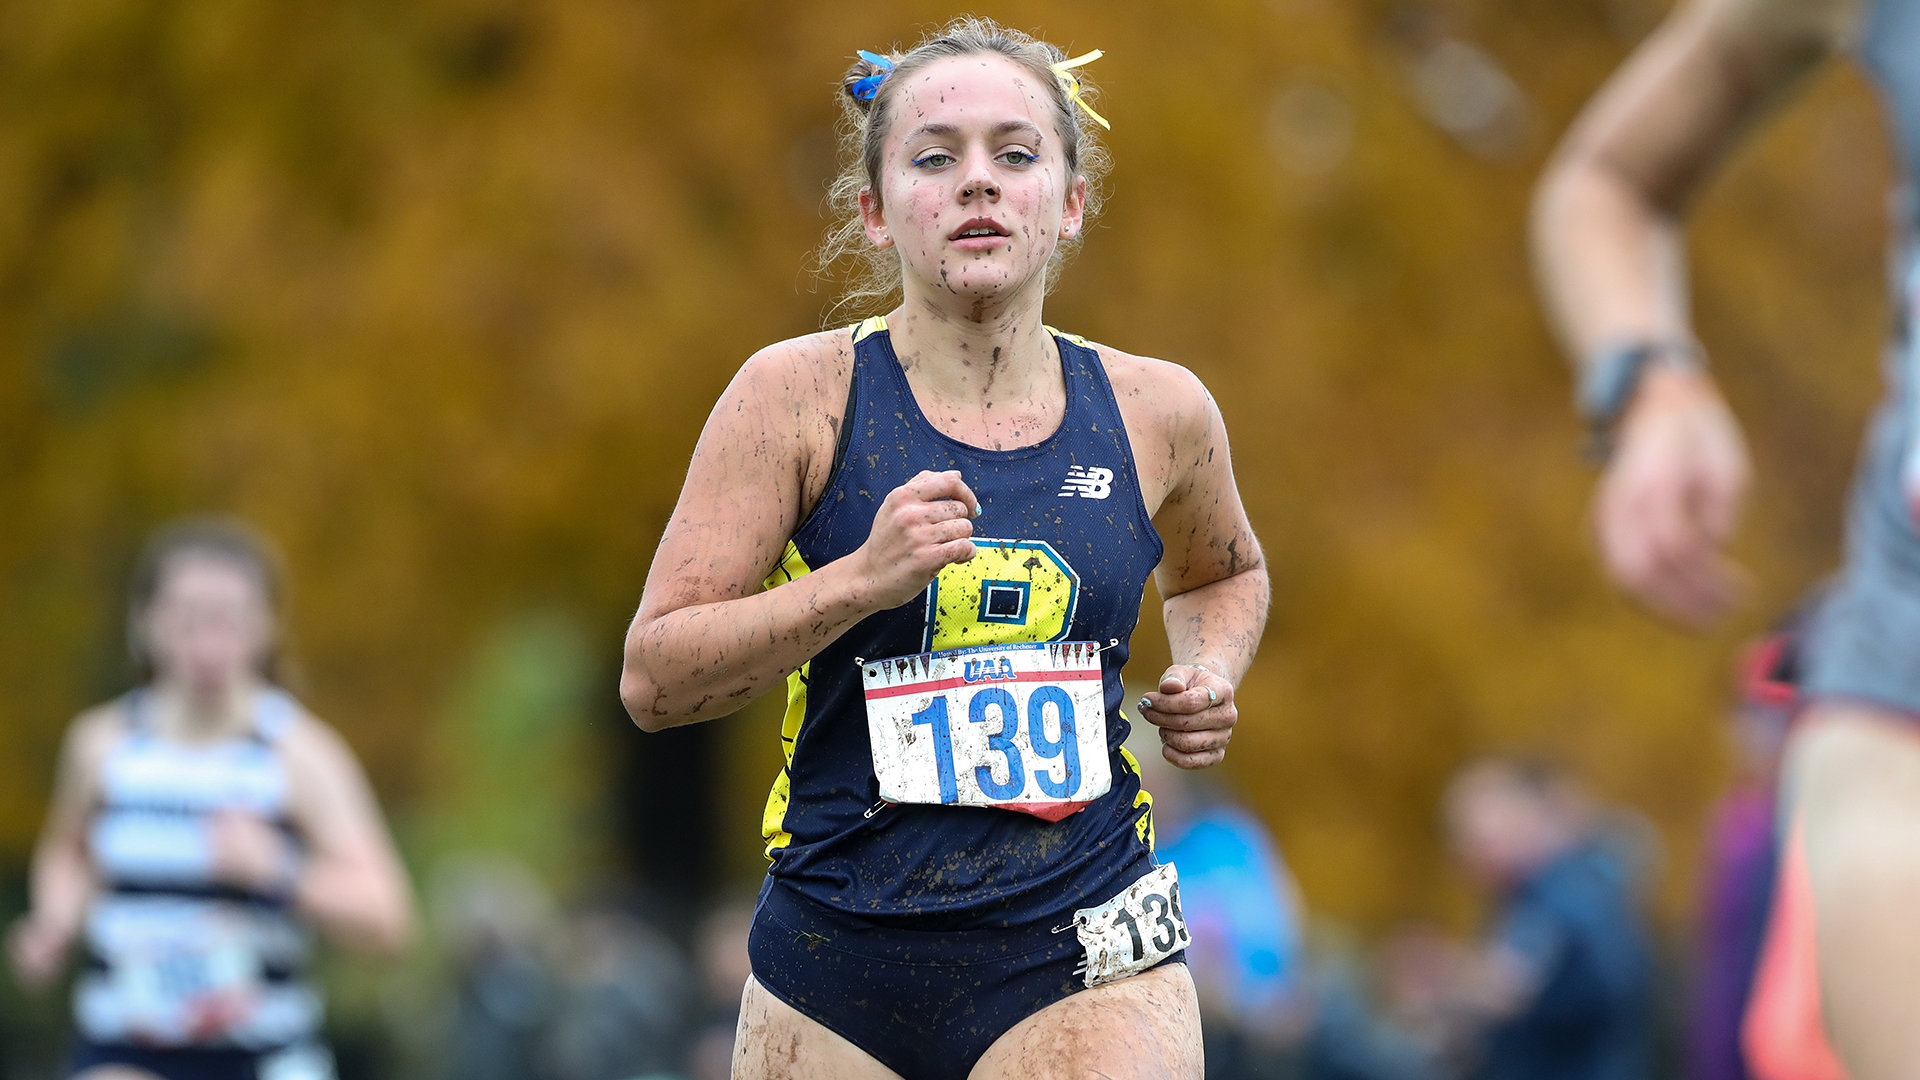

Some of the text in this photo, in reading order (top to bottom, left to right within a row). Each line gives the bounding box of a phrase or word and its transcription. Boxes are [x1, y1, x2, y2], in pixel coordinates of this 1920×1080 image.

[1057, 465, 1114, 500] NB
[979, 645, 1006, 653] University
[963, 658, 1017, 683] UAA
[911, 685, 1082, 805] 139
